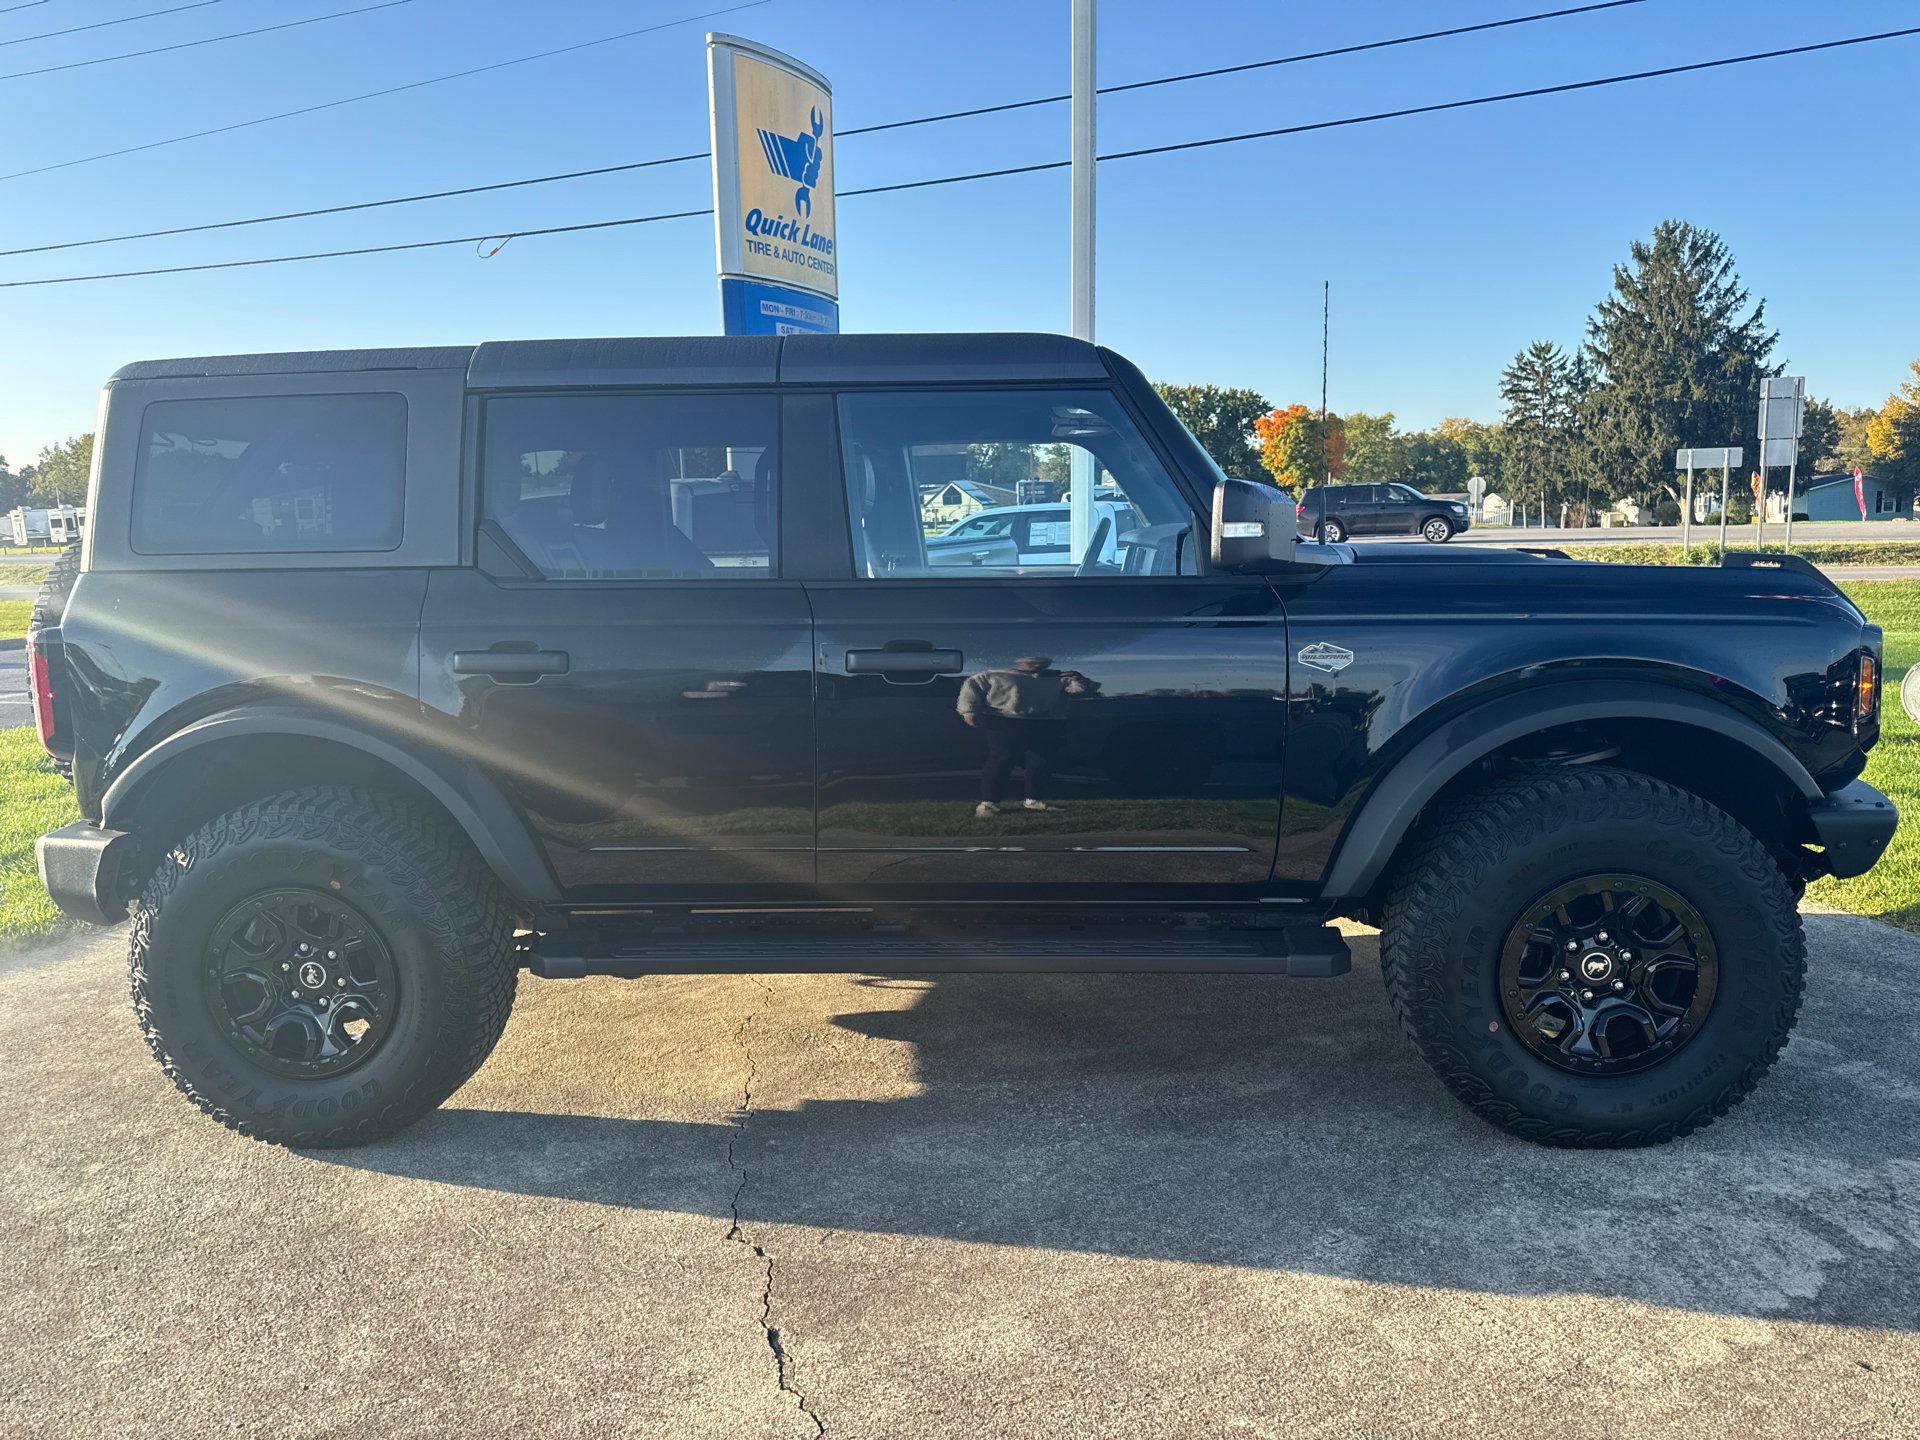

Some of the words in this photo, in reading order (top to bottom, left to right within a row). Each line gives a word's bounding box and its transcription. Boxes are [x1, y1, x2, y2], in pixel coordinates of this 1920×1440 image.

[745, 208, 801, 243] Quick
[801, 224, 833, 255] Lane
[746, 239, 772, 257] TIRE
[773, 245, 780, 259] &
[781, 248, 806, 266] AUTO
[807, 255, 834, 276] CENTER
[762, 303, 779, 314] MON
[785, 307, 796, 317] FRI
[780, 325, 794, 335] SAT
[1457, 926, 1581, 1115] GOODYEAR
[179, 1040, 384, 1121] GOODYEAR
[1648, 1052, 1729, 1108] TERRITORY
